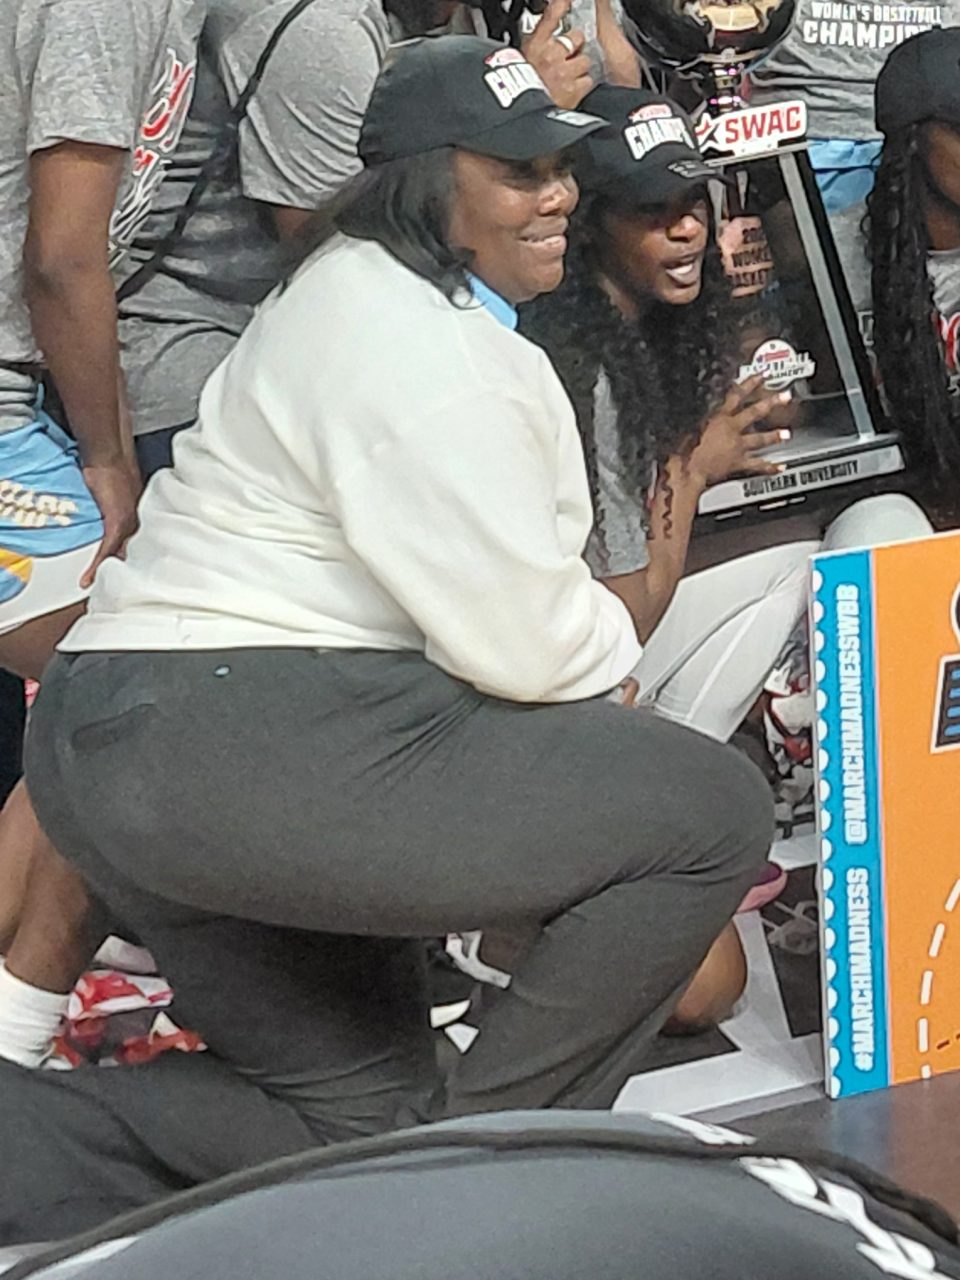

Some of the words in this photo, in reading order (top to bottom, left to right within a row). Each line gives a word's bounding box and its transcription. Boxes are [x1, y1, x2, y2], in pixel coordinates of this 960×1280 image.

[811, 1, 872, 22] WOMEN'S
[873, 5, 942, 23] BASKETBALL
[725, 105, 802, 144] SWAC
[800, 461, 859, 485] UNIVERSITY
[836, 584, 868, 844] @MARCHMADNESSWBB
[853, 869, 872, 1071] #MARCHMADNESS
